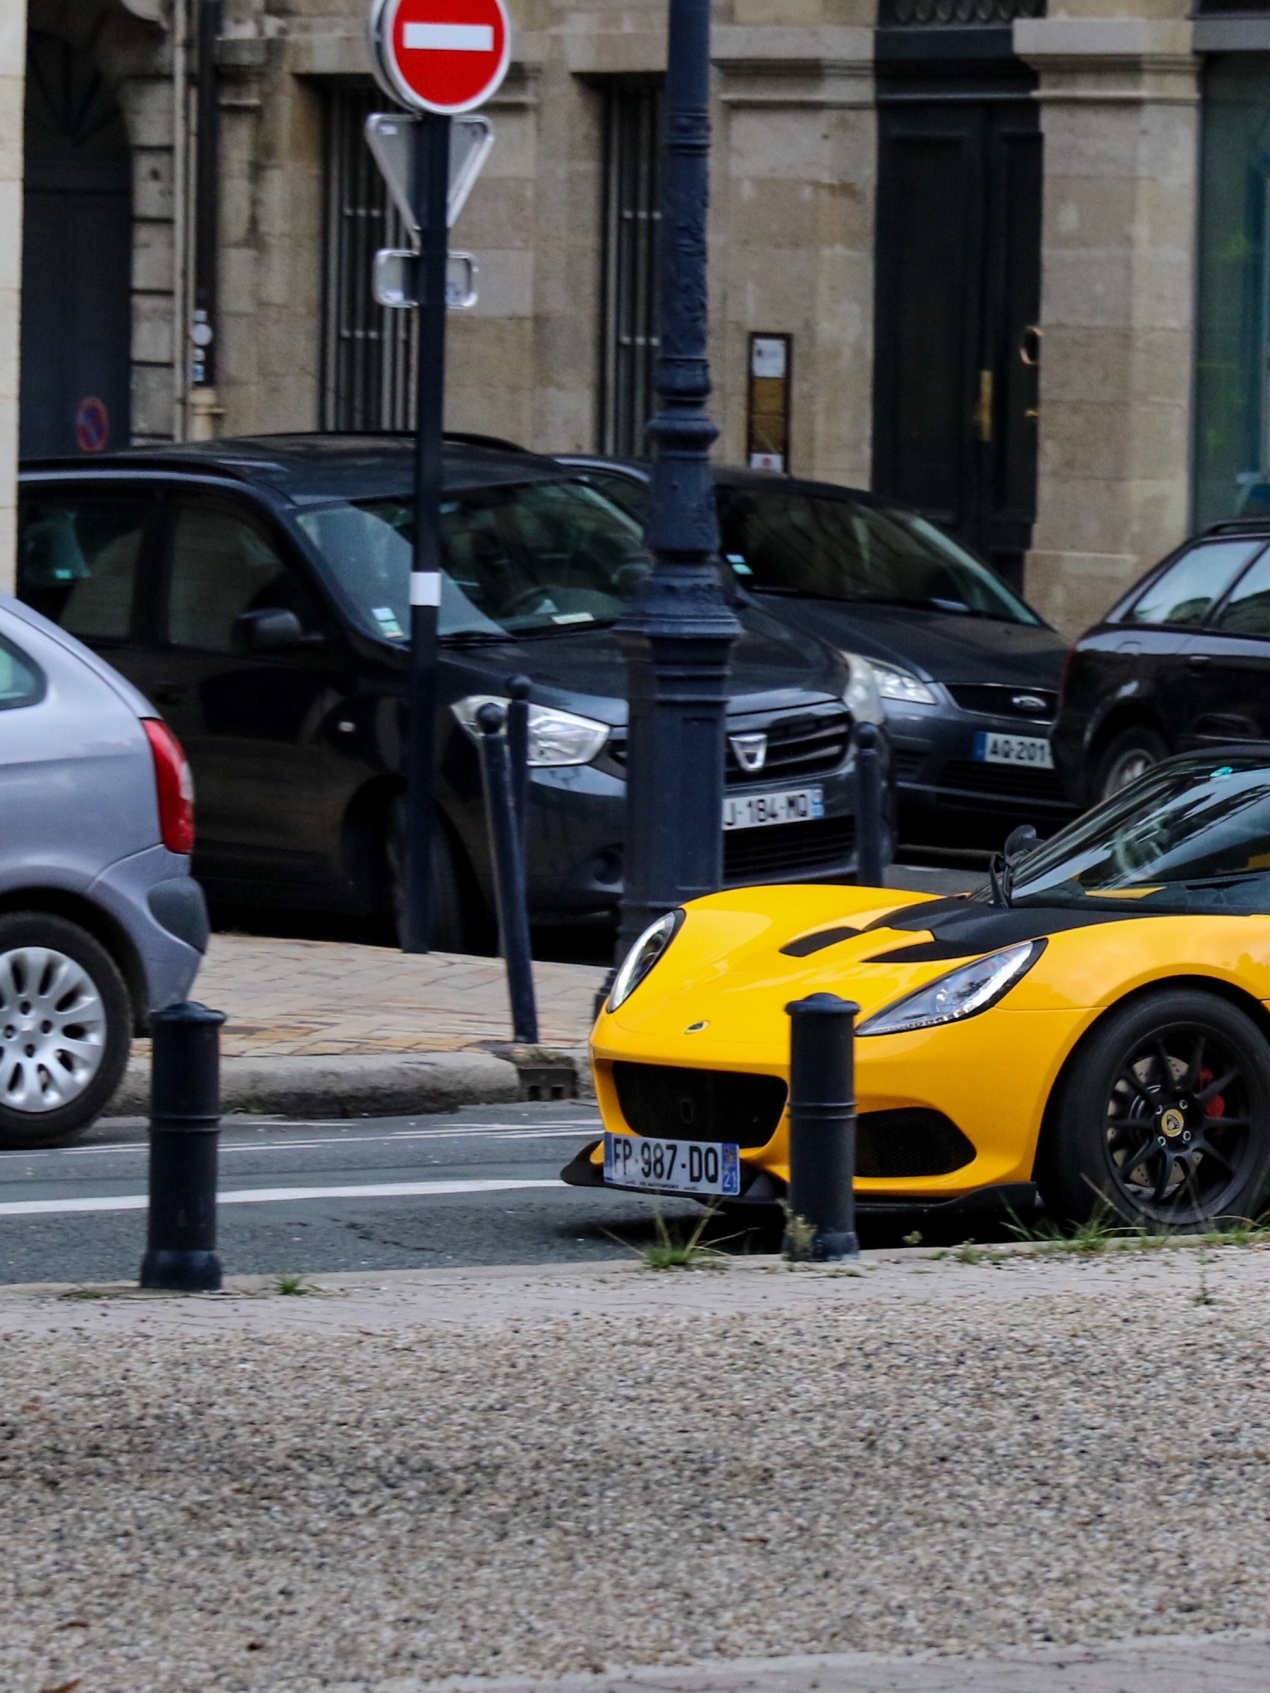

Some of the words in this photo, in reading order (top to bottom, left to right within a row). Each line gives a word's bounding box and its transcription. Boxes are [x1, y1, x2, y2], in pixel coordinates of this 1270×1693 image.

[990, 738, 1050, 762] AQ-201
[722, 793, 807, 827] J-184-MQ
[613, 1137, 719, 1184] FP-987-DQ
[723, 1171, 737, 1188] 21
